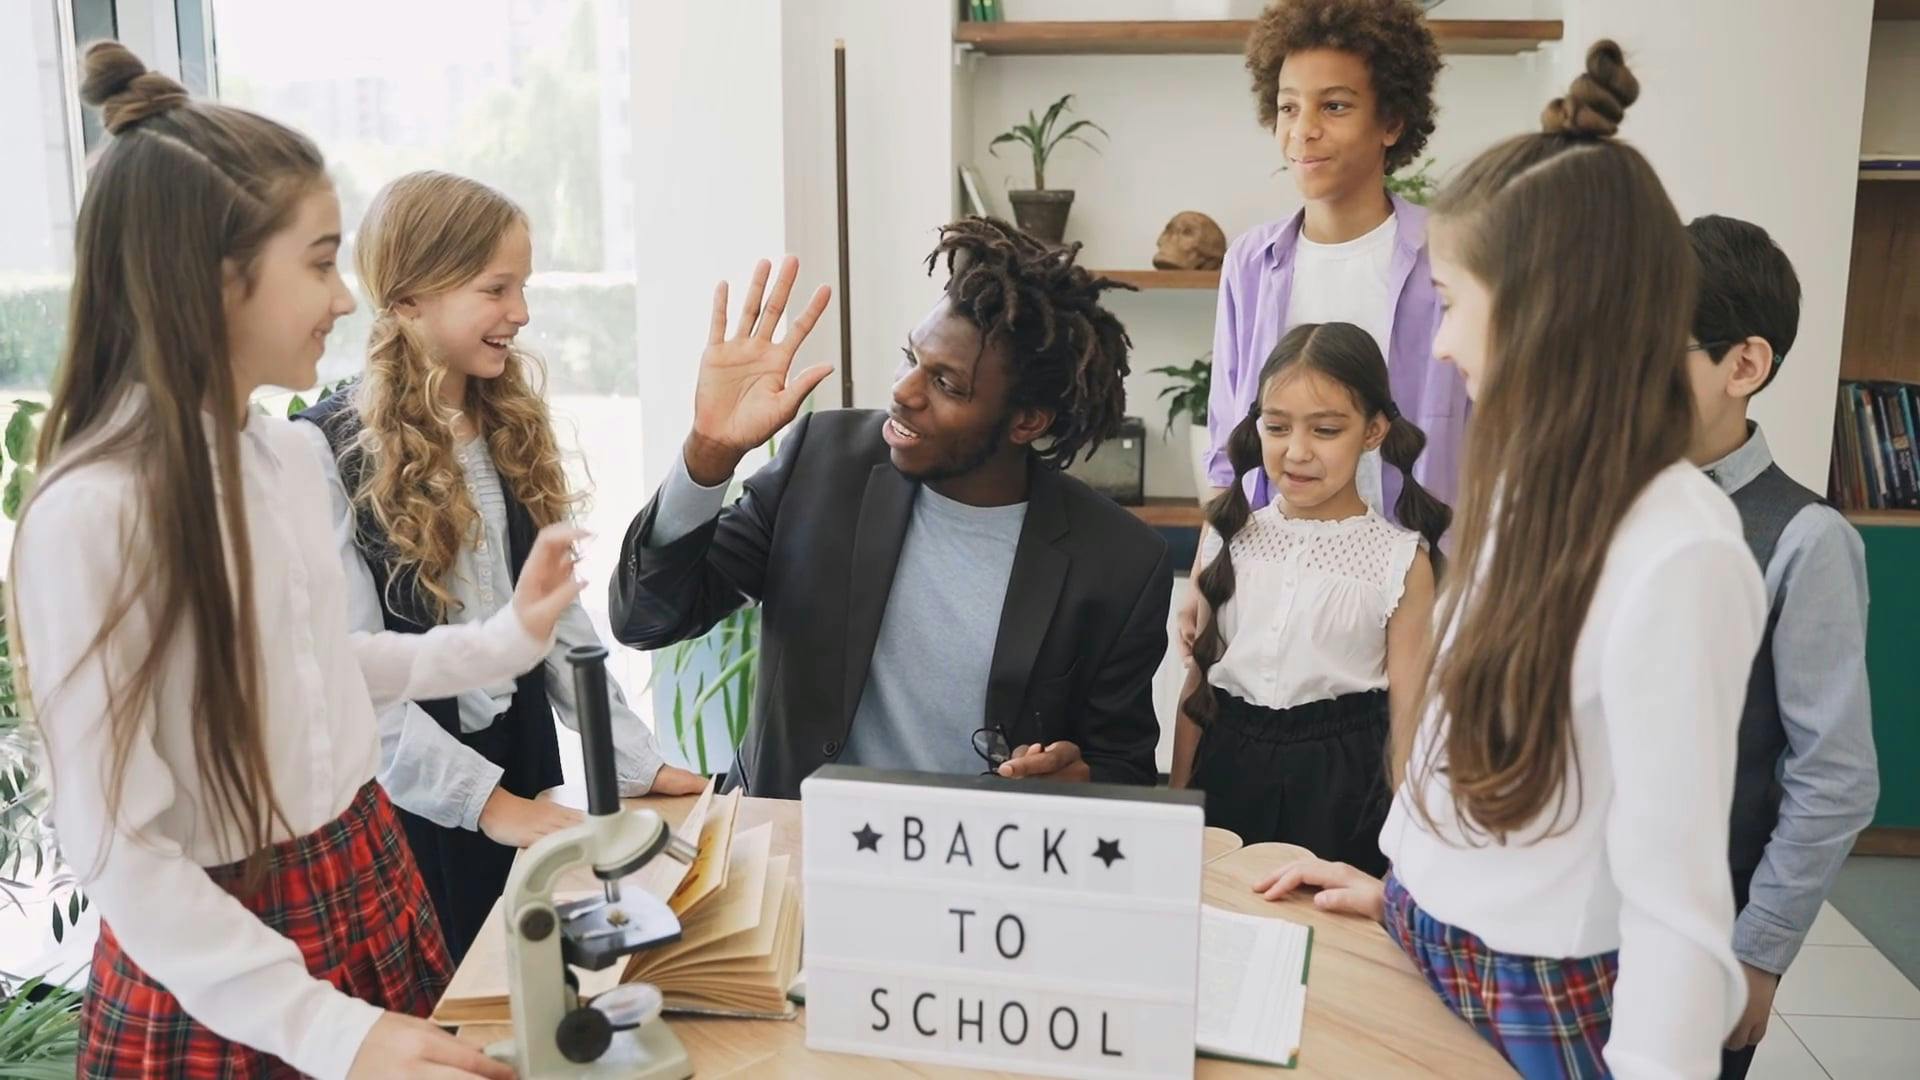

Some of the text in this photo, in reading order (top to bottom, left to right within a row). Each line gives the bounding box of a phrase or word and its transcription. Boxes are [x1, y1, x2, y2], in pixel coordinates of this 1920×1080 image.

[903, 816, 1068, 875] BACK
[948, 908, 1026, 960] TO
[871, 987, 1124, 1057] SCHOOL
